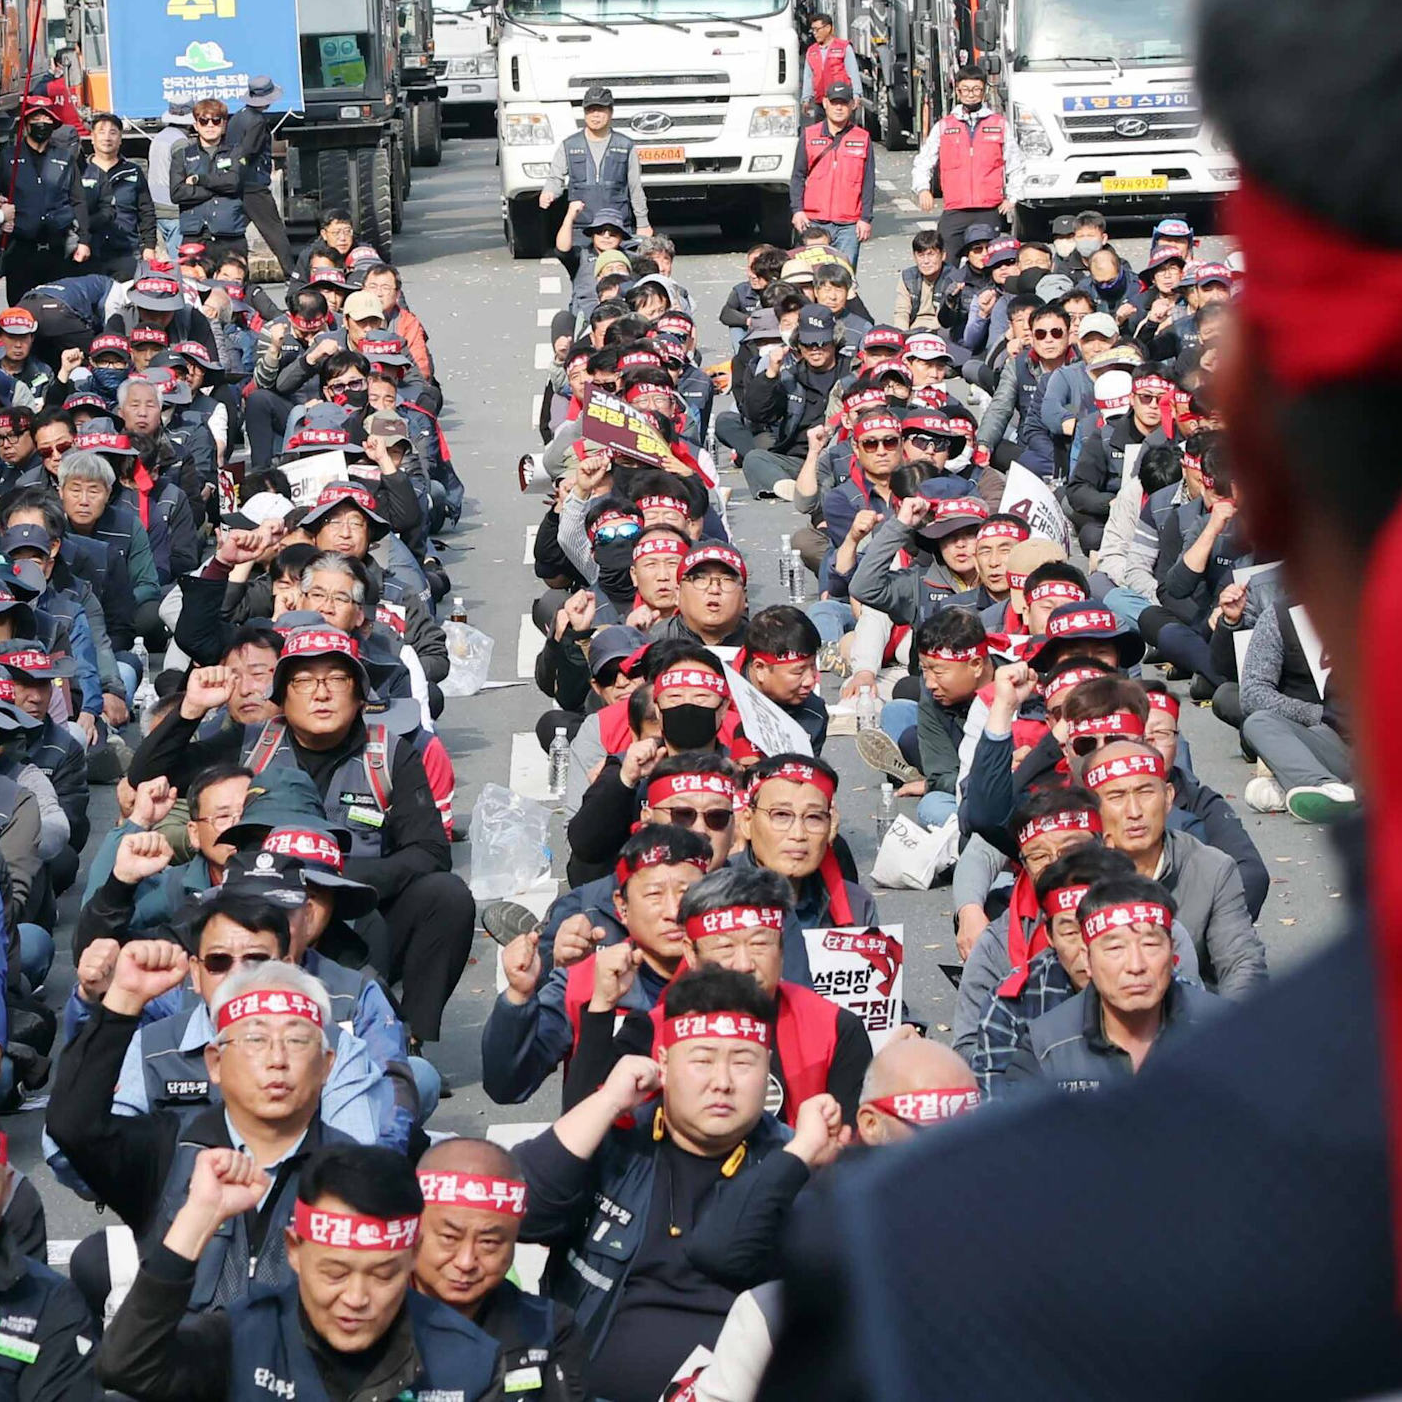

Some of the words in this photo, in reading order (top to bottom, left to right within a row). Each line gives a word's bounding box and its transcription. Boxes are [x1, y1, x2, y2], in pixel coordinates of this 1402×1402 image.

[1137, 94, 1189, 107] 스카이
[1050, 618, 1069, 633] 단결
[1089, 612, 1111, 627] 투쟁
[661, 672, 683, 686] 단결
[1093, 714, 1121, 731] 투쟁
[1087, 770, 1109, 787] 단결
[1131, 757, 1156, 773] 투쟁
[670, 776, 699, 792] 단결
[1057, 809, 1089, 831] 투쟁
[702, 908, 735, 931] 단결
[1085, 915, 1110, 939] 단결
[1134, 904, 1166, 926] 투쟁
[823, 931, 855, 952] 단결
[227, 994, 260, 1018] 단결
[290, 992, 320, 1021] 투쟁
[674, 1013, 711, 1040] 단결
[734, 1013, 768, 1043] 투쟁
[166, 1078, 209, 1095] 단결투쟁
[893, 1091, 939, 1123] 단결
[418, 1171, 455, 1202] 단결
[489, 1175, 527, 1211] 투쟁
[309, 1212, 351, 1246] 단결
[383, 1214, 419, 1249] 투쟁
